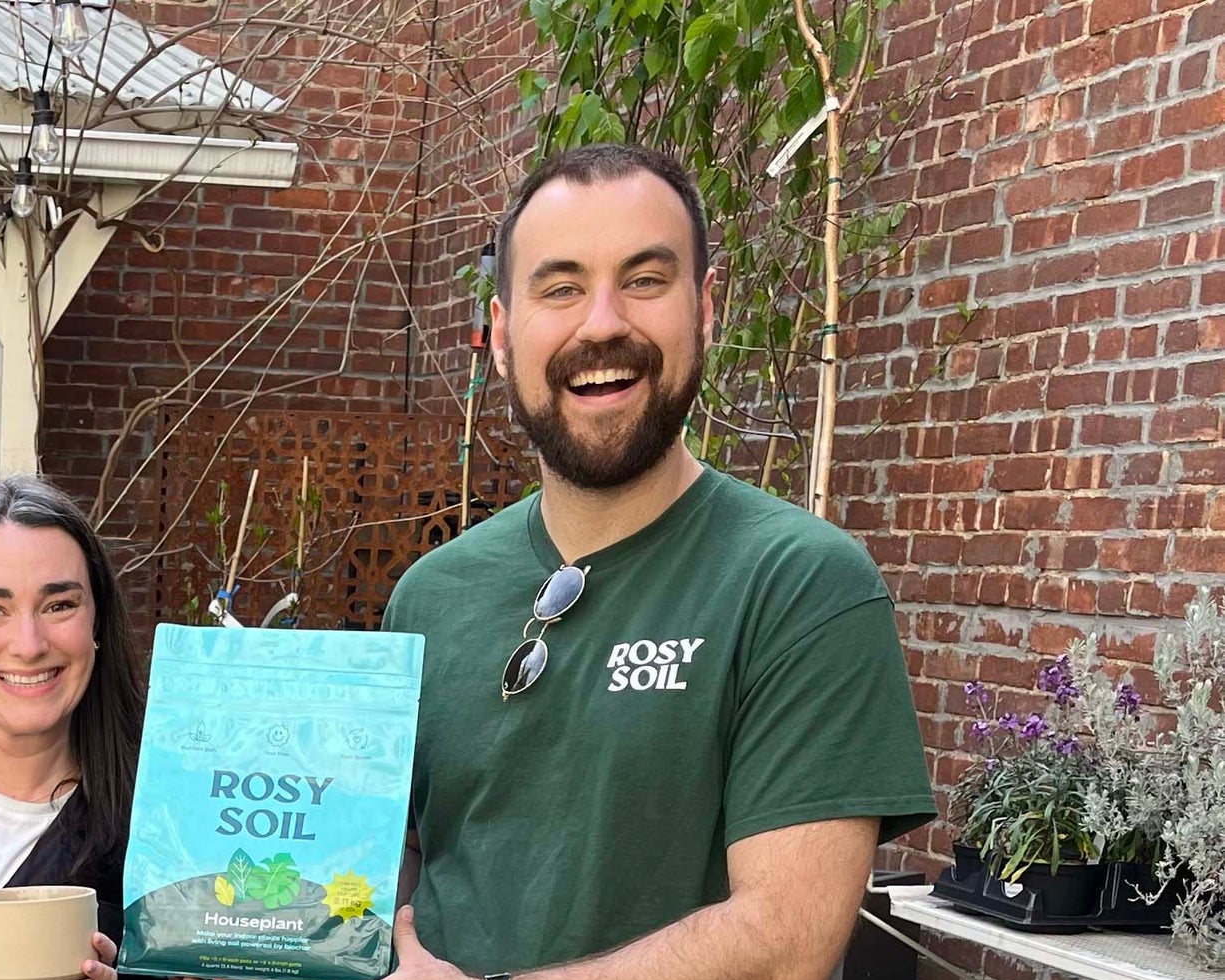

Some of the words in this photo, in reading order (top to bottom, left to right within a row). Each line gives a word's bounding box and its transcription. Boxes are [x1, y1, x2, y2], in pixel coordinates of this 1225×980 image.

[606, 637, 706, 668] ROSY
[607, 663, 688, 692] SOIL
[210, 769, 335, 806] ROSY
[215, 807, 317, 841] SOIL
[204, 911, 304, 931] Houseplant
[217, 931, 234, 939] your
[235, 932, 256, 940] indoor
[207, 938, 227, 947] living
[273, 942, 283, 950] by
